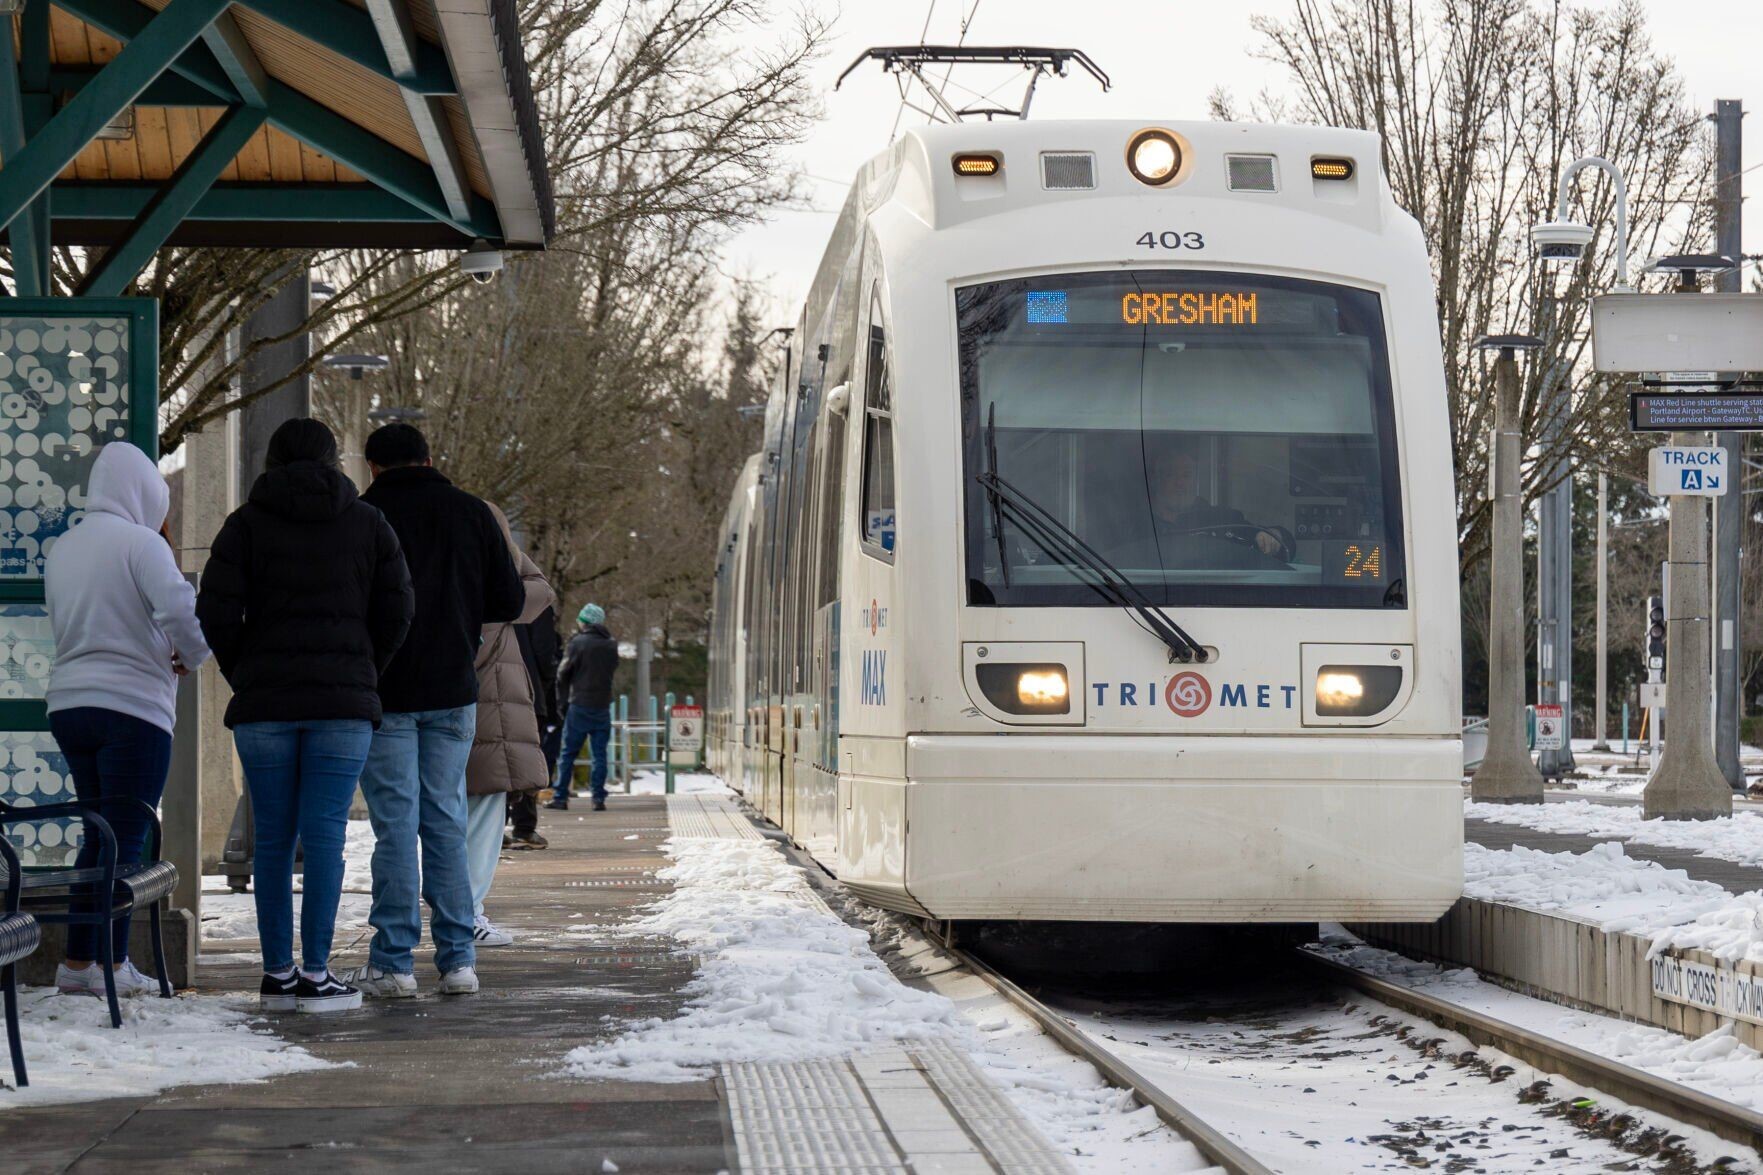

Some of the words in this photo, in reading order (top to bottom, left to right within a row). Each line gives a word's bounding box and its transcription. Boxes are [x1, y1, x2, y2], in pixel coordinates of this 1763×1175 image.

[1135, 231, 1206, 250] 403
[1122, 292, 1258, 325] GRESHAM
[1650, 399, 1665, 407] MAX
[1667, 399, 1680, 407] Red
[1681, 399, 1696, 407] Line
[1697, 398, 1722, 406] shuttle
[1722, 398, 1749, 408] serving
[1650, 407, 1681, 415] Portland
[1681, 407, 1706, 417] Airport
[1650, 416, 1666, 424] Line
[1678, 415, 1703, 423] service
[1703, 415, 1722, 423] btwn
[1722, 415, 1753, 424] Gateway
[1663, 452, 1721, 465] TRACK
[1684, 471, 1700, 489] A
[1344, 546, 1379, 577] 24
[862, 609, 872, 629] TRI
[878, 607, 888, 628] MET
[861, 650, 886, 706] MAX
[1092, 683, 1156, 706] TRI
[1219, 684, 1297, 709] MET
[1655, 959, 1665, 992] DO
[1667, 962, 1682, 997] NOT
[1686, 967, 1717, 1006] CROSS
